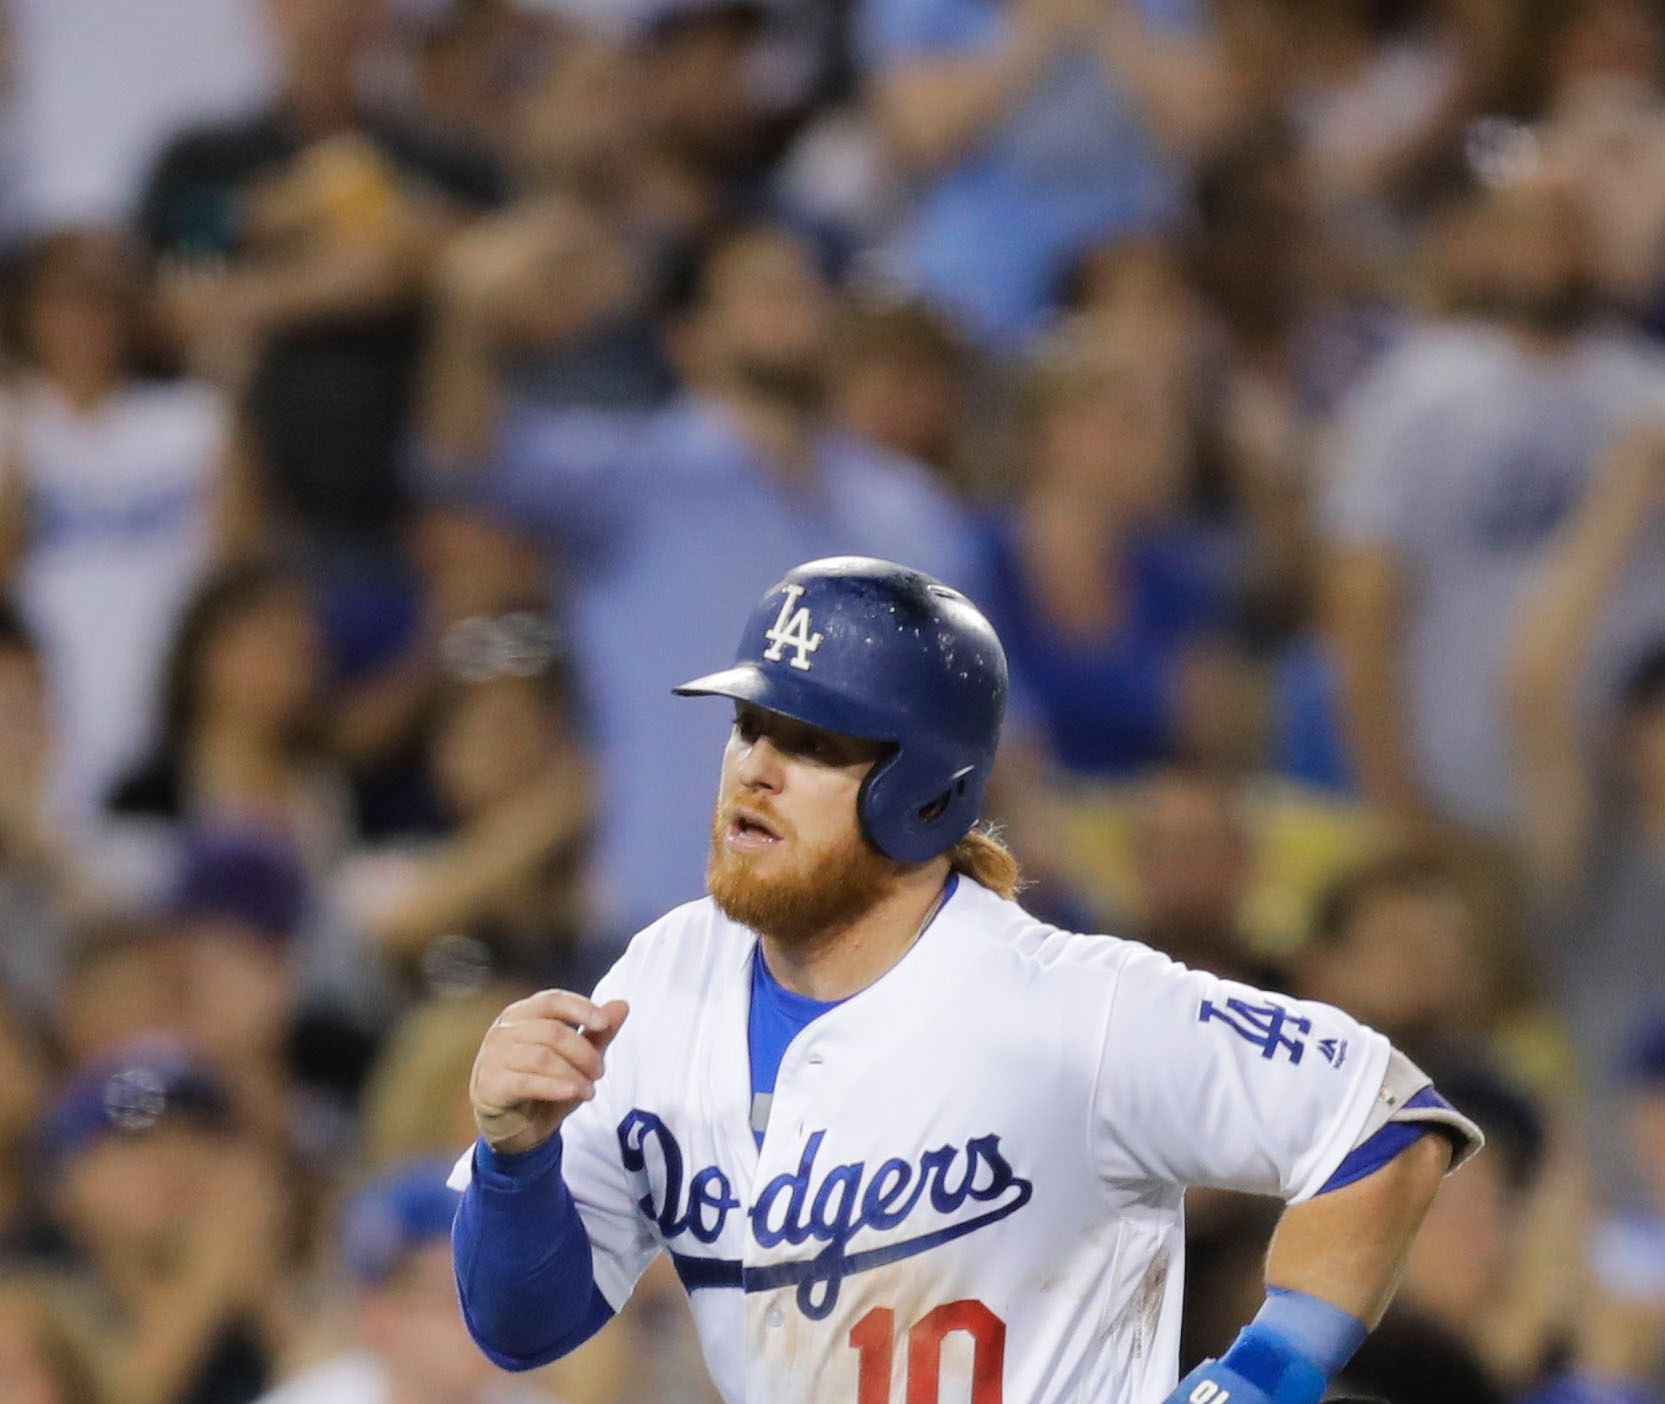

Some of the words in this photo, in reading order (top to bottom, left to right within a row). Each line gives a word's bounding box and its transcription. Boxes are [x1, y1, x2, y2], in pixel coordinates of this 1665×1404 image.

[763, 583, 823, 671] LA
[1199, 997, 1311, 1066] LA
[618, 1107, 1033, 1320] Dodgers
